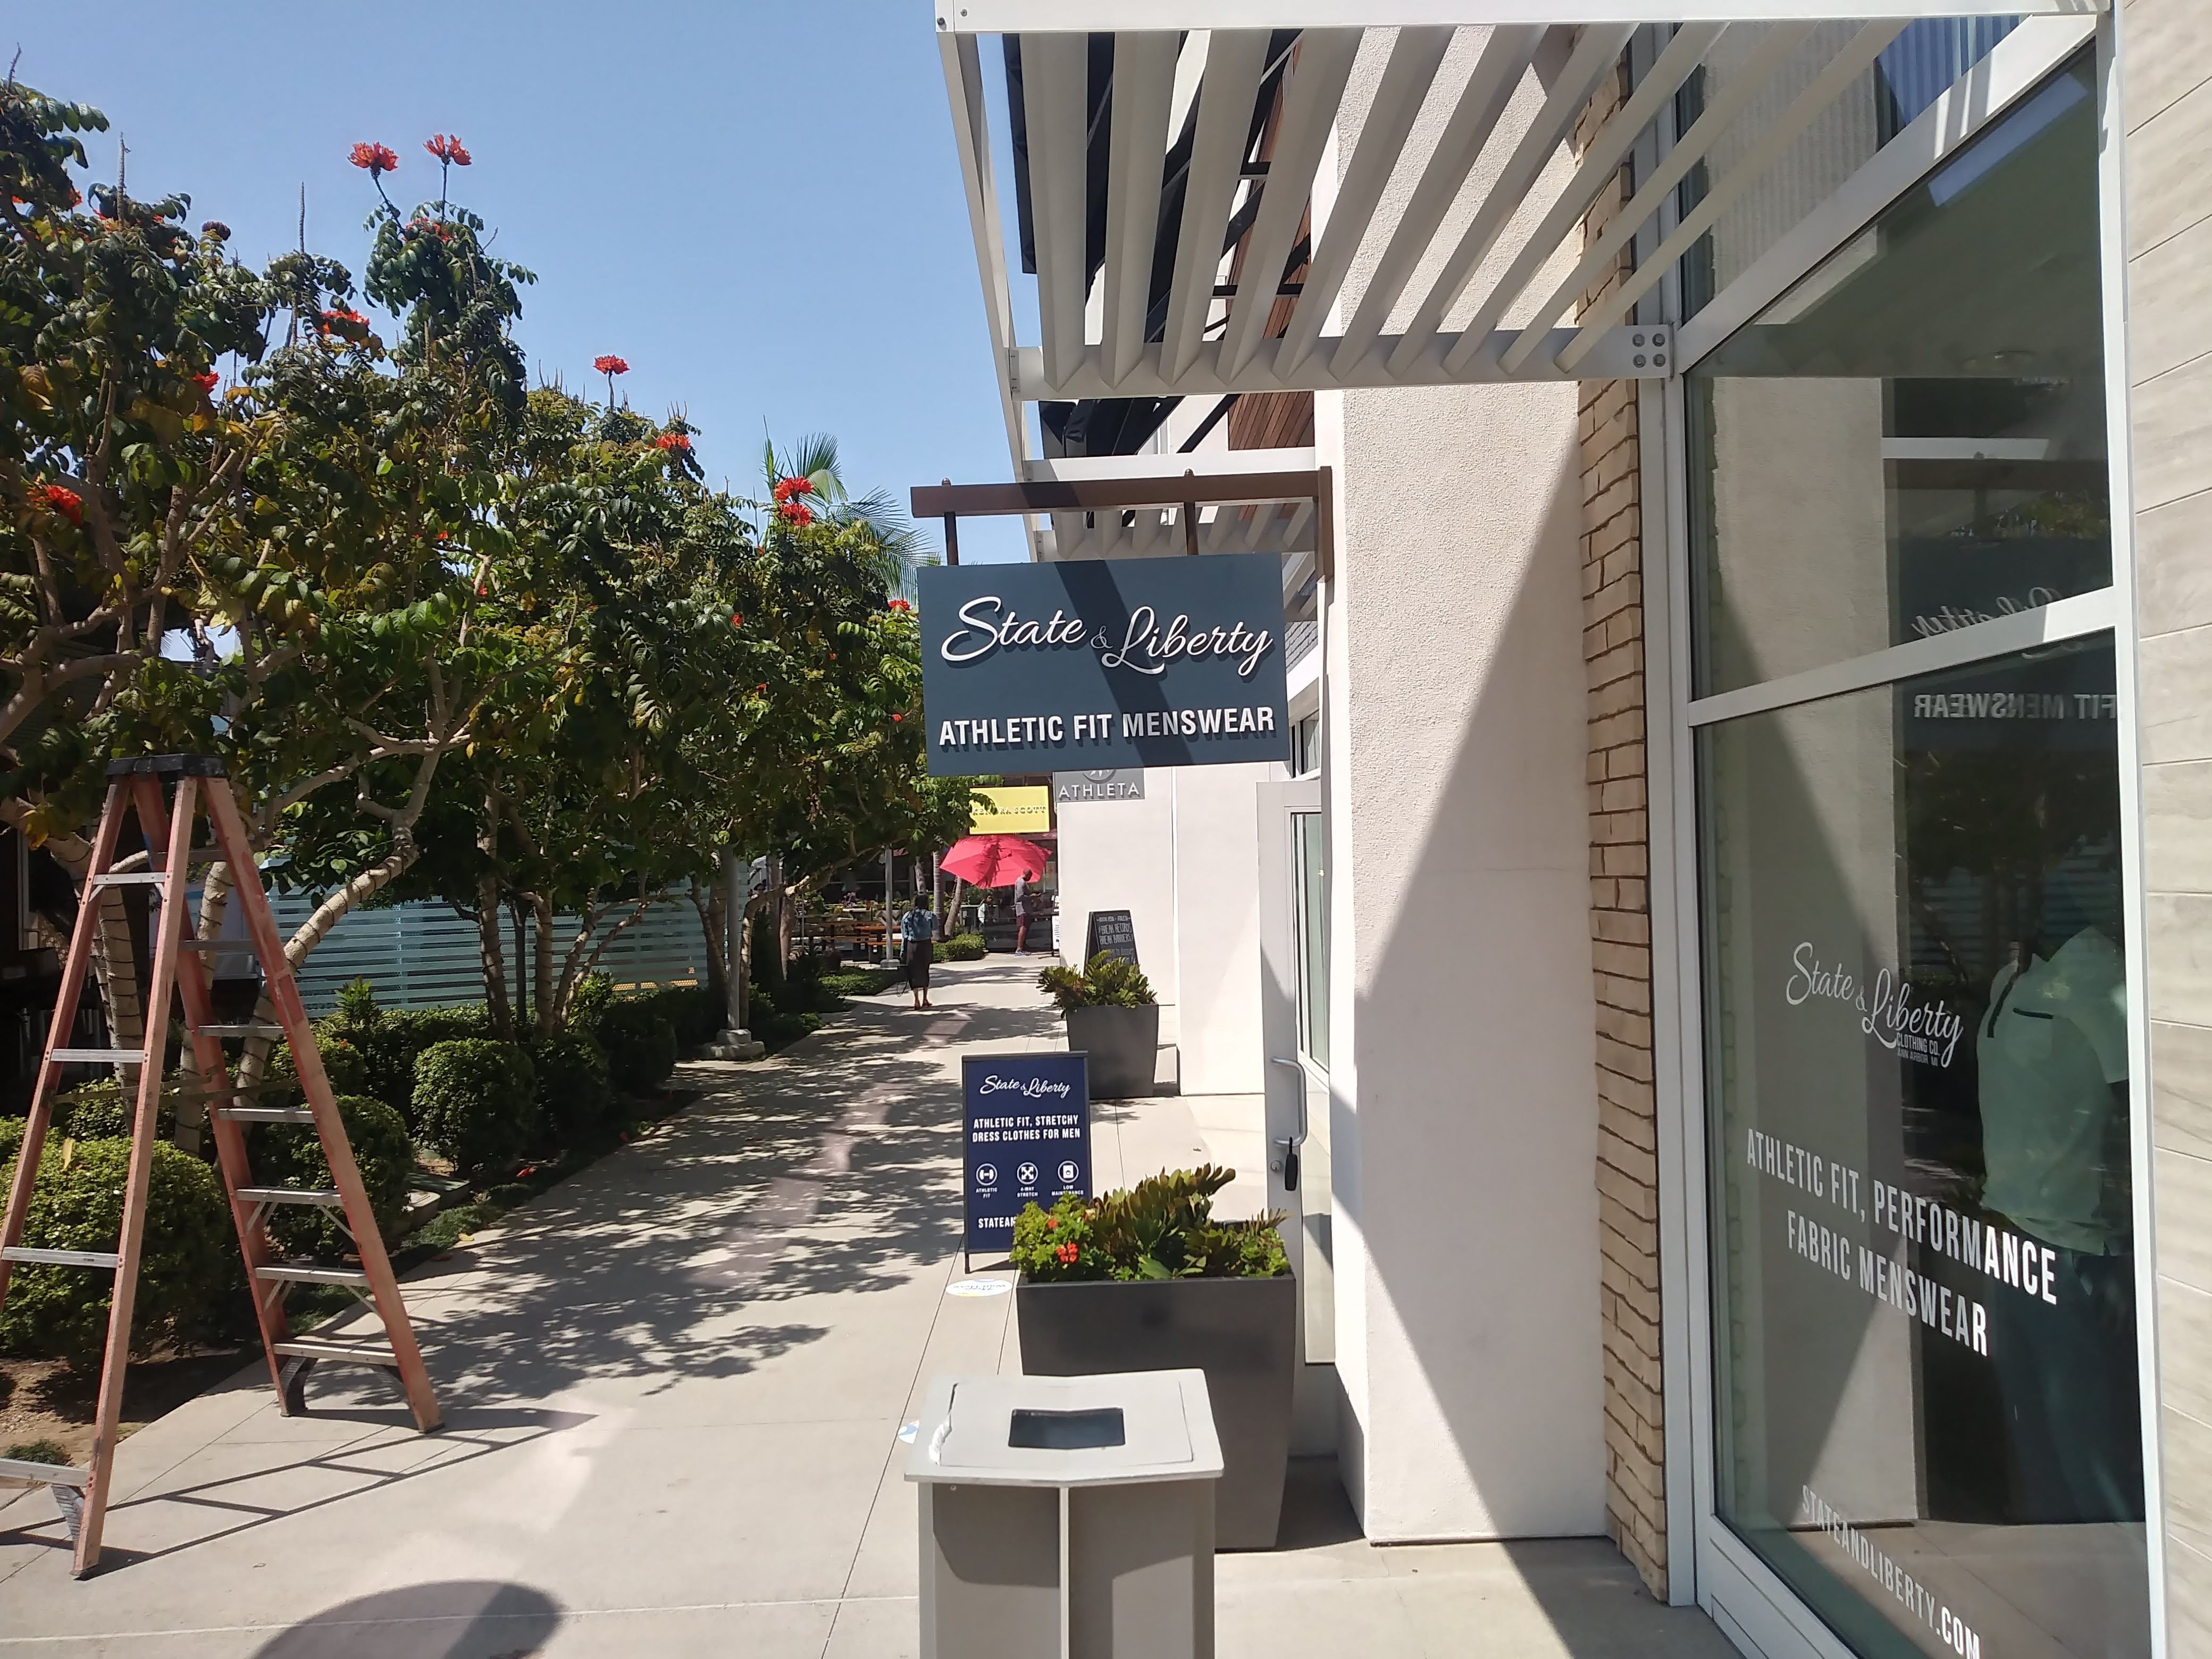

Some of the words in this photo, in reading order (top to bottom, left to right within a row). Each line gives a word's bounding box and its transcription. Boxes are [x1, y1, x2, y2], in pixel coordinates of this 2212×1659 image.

[941, 596, 1087, 661] State
[1091, 625, 1113, 649] &
[1101, 606, 1273, 676] Liberty
[939, 715, 1063, 745] ATHLETIC
[1074, 713, 1112, 740] FIT
[1122, 706, 1275, 738] MENSWEAR
[1059, 782, 1140, 798] ATHLETA
[973, 807, 1011, 816] KERA
[1013, 805, 1046, 815] SCOTT
[1786, 942, 1855, 1005] State
[1856, 985, 1867, 1012] &
[1862, 968, 1963, 1068] Liberty
[1897, 1032, 1928, 1053] CLOTHING
[1929, 1040, 1940, 1056] CO.
[980, 1075, 1020, 1094] State
[1024, 1077, 1071, 1098] Liberty
[973, 1130, 1000, 1143] DRESS
[1003, 1129, 1040, 1141] CLOTHES
[1043, 1128, 1059, 1139] FOR
[1062, 1127, 1080, 1139] MEN
[974, 1117, 1014, 1129] ATHLETIC
[1017, 1116, 1032, 1128] FIT,
[1035, 1115, 1078, 1126] STRETCHY
[1747, 1128, 1823, 1198] ATHLETIC
[1831, 1162, 1865, 1222] FIT,
[1874, 1179, 2057, 1305] PERFORMANCE
[1788, 1210, 1850, 1280] FABRIC
[1859, 1245, 1988, 1356] MENSWEAR
[1803, 1485, 1980, 1659] STATEANDLIBERTY.COM
